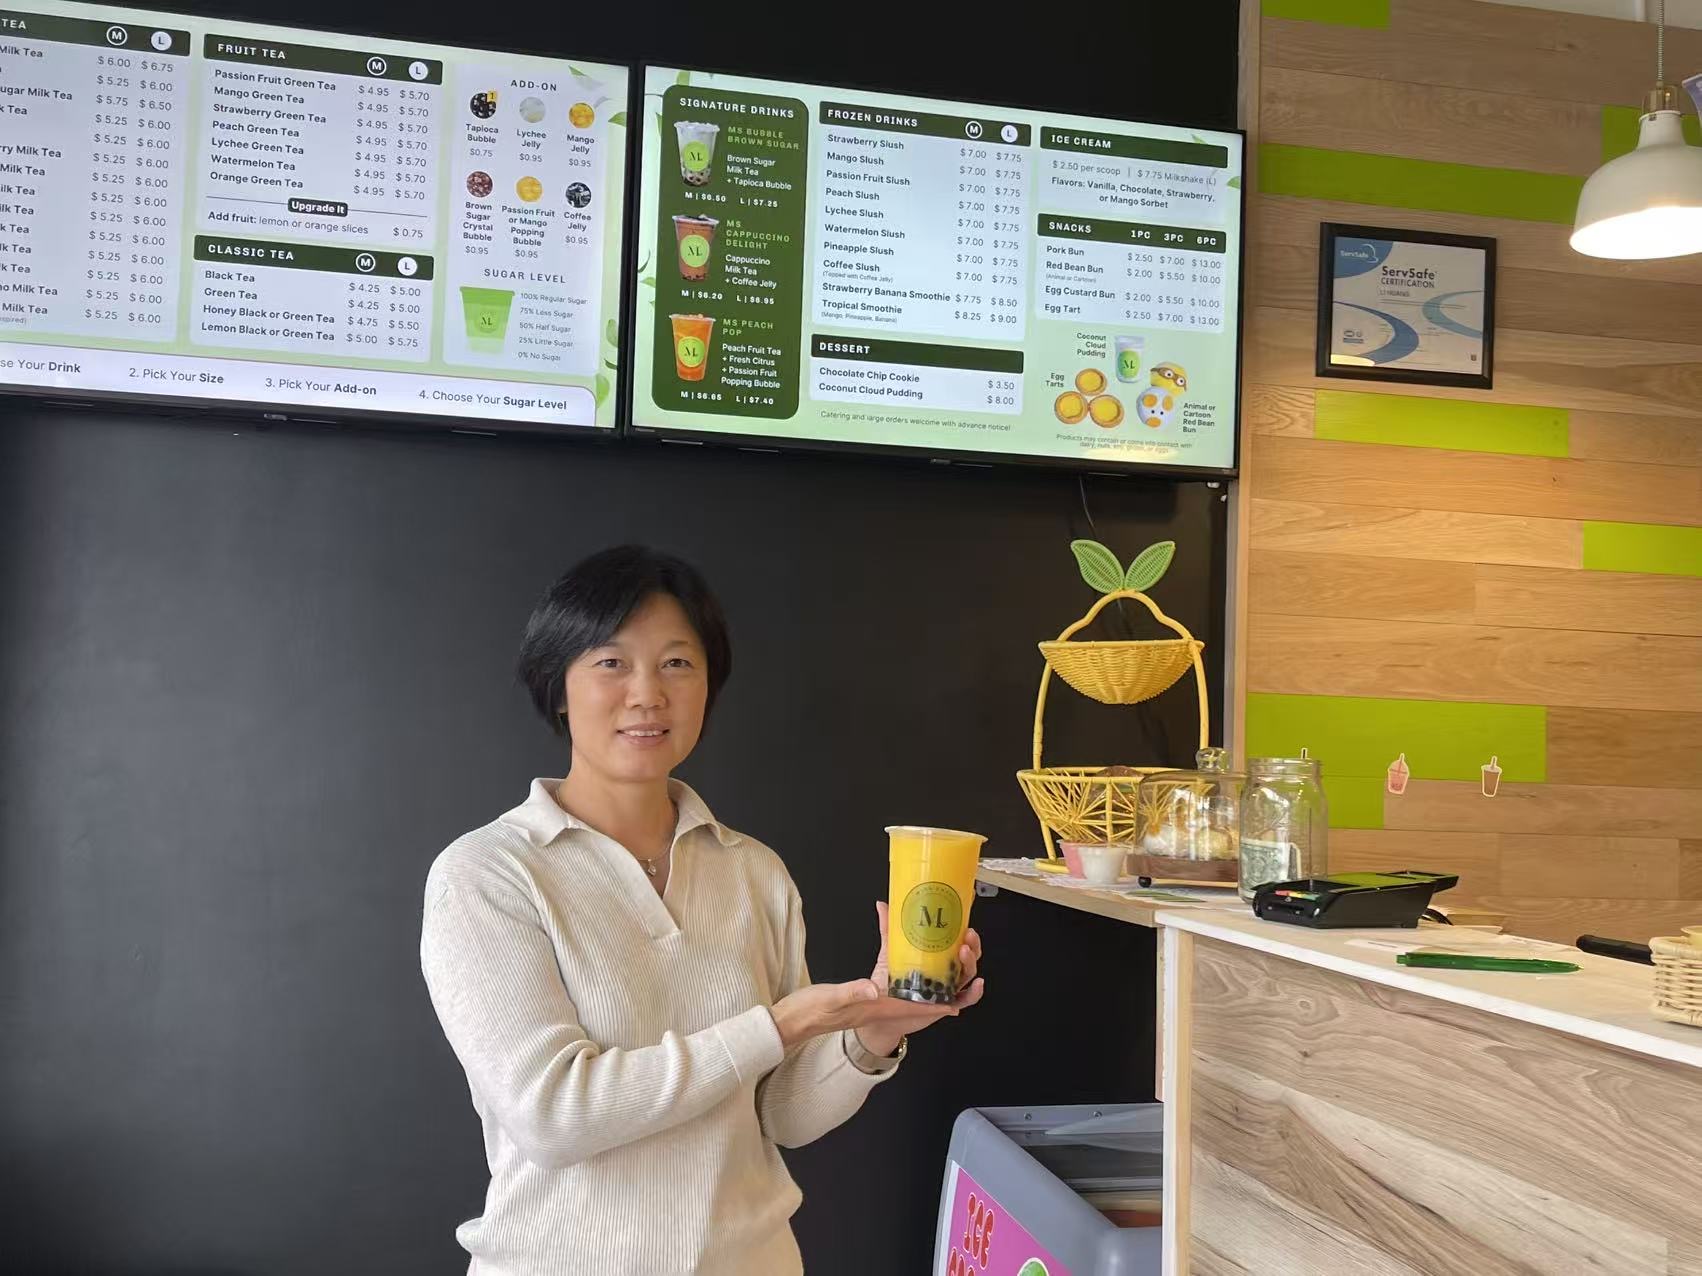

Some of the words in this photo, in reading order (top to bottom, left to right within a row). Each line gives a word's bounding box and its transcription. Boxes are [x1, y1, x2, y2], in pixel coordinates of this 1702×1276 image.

[1, 19, 26, 29] TEA
[218, 44, 257, 55] FRUIT
[262, 49, 286, 59] TEA
[215, 69, 255, 81] Passion
[257, 74, 282, 84] Fruit
[284, 77, 315, 88] Green
[317, 81, 336, 90] Tea
[510, 80, 557, 91] ADD-ON
[28, 88, 50, 97] Milk
[53, 90, 73, 100] Tea
[214, 87, 250, 99] Mango
[252, 91, 283, 101] Green
[286, 94, 305, 103] Tea
[213, 104, 272, 118] Strawberry
[274, 110, 305, 120] Green
[308, 114, 326, 123] Tea
[679, 98, 746, 112] SIGNATURE
[751, 106, 794, 118] DRINKS
[828, 110, 871, 121] FROZEN
[875, 115, 918, 126] DRINKS
[466, 124, 499, 133] Tapioca
[516, 129, 547, 138] Lychee
[467, 134, 496, 143] Bubble
[521, 140, 541, 149] Jelly
[567, 135, 595, 144] Mango
[828, 134, 878, 148] Strawberry
[880, 140, 904, 149] Slush
[1052, 135, 1070, 144] ICE
[1073, 137, 1111, 148] CREAM
[470, 148, 493, 157] $0.75
[571, 145, 590, 155] Jelly
[211, 155, 274, 168] Watermelon
[276, 161, 295, 170] Tea
[519, 153, 543, 162] $0.95
[727, 155, 752, 163] Brown
[753, 157, 776, 167] Sugar
[827, 152, 858, 163] Mango
[859, 156, 884, 165] Slush
[726, 165, 743, 174] Milk
[744, 167, 759, 175] Tea
[210, 172, 249, 184] Orange
[250, 176, 282, 186] Green
[284, 179, 303, 188] Tea
[826, 170, 861, 180] Passion
[863, 174, 884, 183] Fruit
[886, 176, 910, 185] Slush
[1087, 181, 1118, 192] Vanilla,
[1120, 184, 1164, 196] Chocolate,
[465, 202, 492, 210] Brown
[1110, 195, 1139, 206] Mango
[1140, 198, 1169, 208] Sorbet
[292, 201, 335, 215] Upgrade
[337, 205, 344, 213] It
[207, 211, 229, 221] Add
[232, 213, 257, 223] fruit:
[259, 217, 289, 226] lemon
[304, 222, 339, 232] orange
[342, 225, 369, 234] slices
[466, 212, 491, 221] Sugar
[463, 222, 493, 231] Crystal
[824, 224, 879, 236] Watermelon
[881, 229, 905, 238] Slush
[1049, 222, 1091, 233] SNACKS
[1131, 230, 1150, 239] 1PC
[1164, 233, 1184, 242] 3PC
[463, 232, 492, 241] Bubble
[208, 245, 265, 257] CLASSIC
[270, 250, 294, 260] TEA
[824, 242, 868, 253] Pineapple
[869, 246, 894, 255] Slush
[1046, 245, 1066, 254] Pork
[725, 254, 771, 265] Cappuccino
[823, 260, 854, 269] Coffee
[855, 263, 880, 272] Slush
[1046, 261, 1063, 269] Red
[1064, 263, 1086, 271] Bean
[1087, 265, 1104, 273] Bun
[205, 271, 233, 280] Black
[236, 273, 255, 282] Tea
[484, 269, 525, 279] SUGAR
[530, 273, 566, 283] LEVEL
[1382, 266, 1435, 280] ServSafe
[732, 277, 758, 286] Coffee
[759, 280, 777, 289] Jelly
[1381, 278, 1435, 288] CERTIFICATION
[204, 288, 236, 298] Green
[238, 290, 258, 299] Tea
[822, 283, 873, 296] Strawberry
[874, 287, 907, 297] Banana
[909, 291, 951, 301] Smoothie
[1045, 285, 1062, 295] Egg
[1063, 287, 1098, 297] Custard
[1099, 290, 1116, 298] Bun
[822, 299, 859, 310] Tropical
[860, 303, 902, 313] Smoothie
[1044, 304, 1061, 313] Egg
[1064, 305, 1081, 313] Tart
[203, 305, 237, 317] Honey
[239, 308, 267, 317] Black
[282, 312, 314, 321] Green
[316, 314, 335, 323] Tea
[1076, 333, 1107, 341] Coconut
[722, 343, 746, 352] Peach
[747, 345, 765, 354] Fruit
[767, 347, 781, 355] Tea
[819, 342, 870, 353] DESSERT
[1085, 341, 1107, 349] Cloud
[1077, 349, 1106, 358] Pudding
[18, 360, 45, 370] Your
[48, 362, 81, 373] Drink
[729, 355, 751, 363] Fresh
[752, 357, 775, 366] Citrus
[129, 368, 139, 377] 2.
[143, 369, 167, 379] Pick
[170, 371, 197, 381] Your
[199, 373, 224, 383] Size
[819, 367, 865, 378] Chocolate
[866, 371, 888, 381] Chip
[889, 373, 920, 382] Cookie
[1050, 373, 1065, 381] Egg
[265, 378, 275, 387] 3.
[279, 379, 302, 389] Pick
[305, 381, 331, 391] Your
[334, 384, 377, 395] Add-on
[819, 383, 857, 392] Coconut
[859, 386, 885, 395] Cloud
[886, 388, 923, 399] Pudding
[419, 390, 429, 399] 4.
[432, 391, 473, 402] Choose
[476, 394, 501, 404] Your
[503, 396, 536, 408] Sugar
[538, 399, 567, 409] Level
